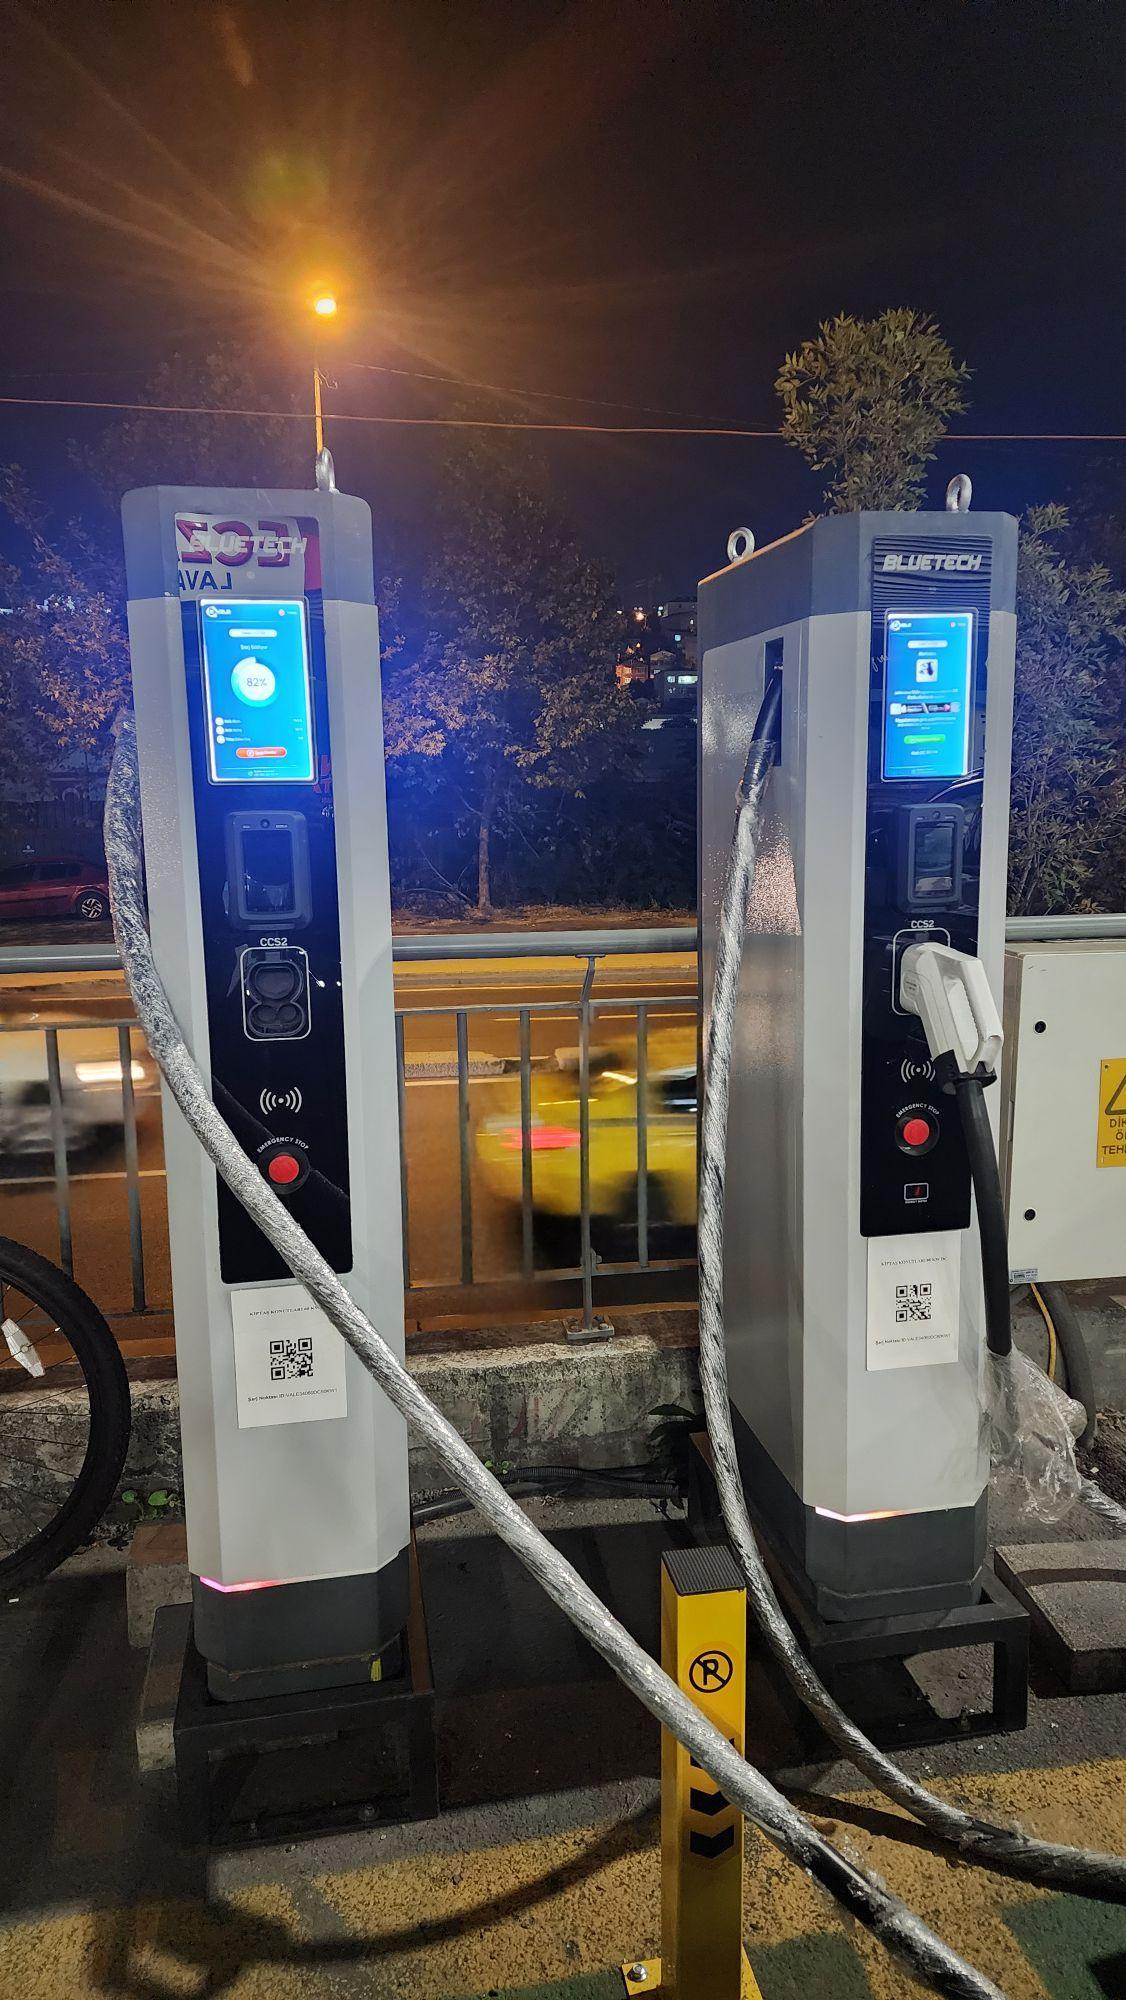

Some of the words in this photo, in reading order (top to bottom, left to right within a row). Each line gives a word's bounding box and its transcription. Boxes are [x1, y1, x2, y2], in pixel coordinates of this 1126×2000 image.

[190, 534, 308, 554] BLUETECH
[882, 554, 983, 571] BLUETECH
[246, 677, 268, 687] 82%
[911, 919, 935, 929] CCS2
[259, 937, 288, 947] CCS2
[895, 1103, 927, 1118] EMERGENCY
[928, 1105, 940, 1115] STOP
[1115, 1129, 1126, 1140] Ö
[256, 1136, 294, 1153] EMERGENCY
[295, 1138, 309, 1149] STOP
[1101, 1145, 1126, 1155] TEH
